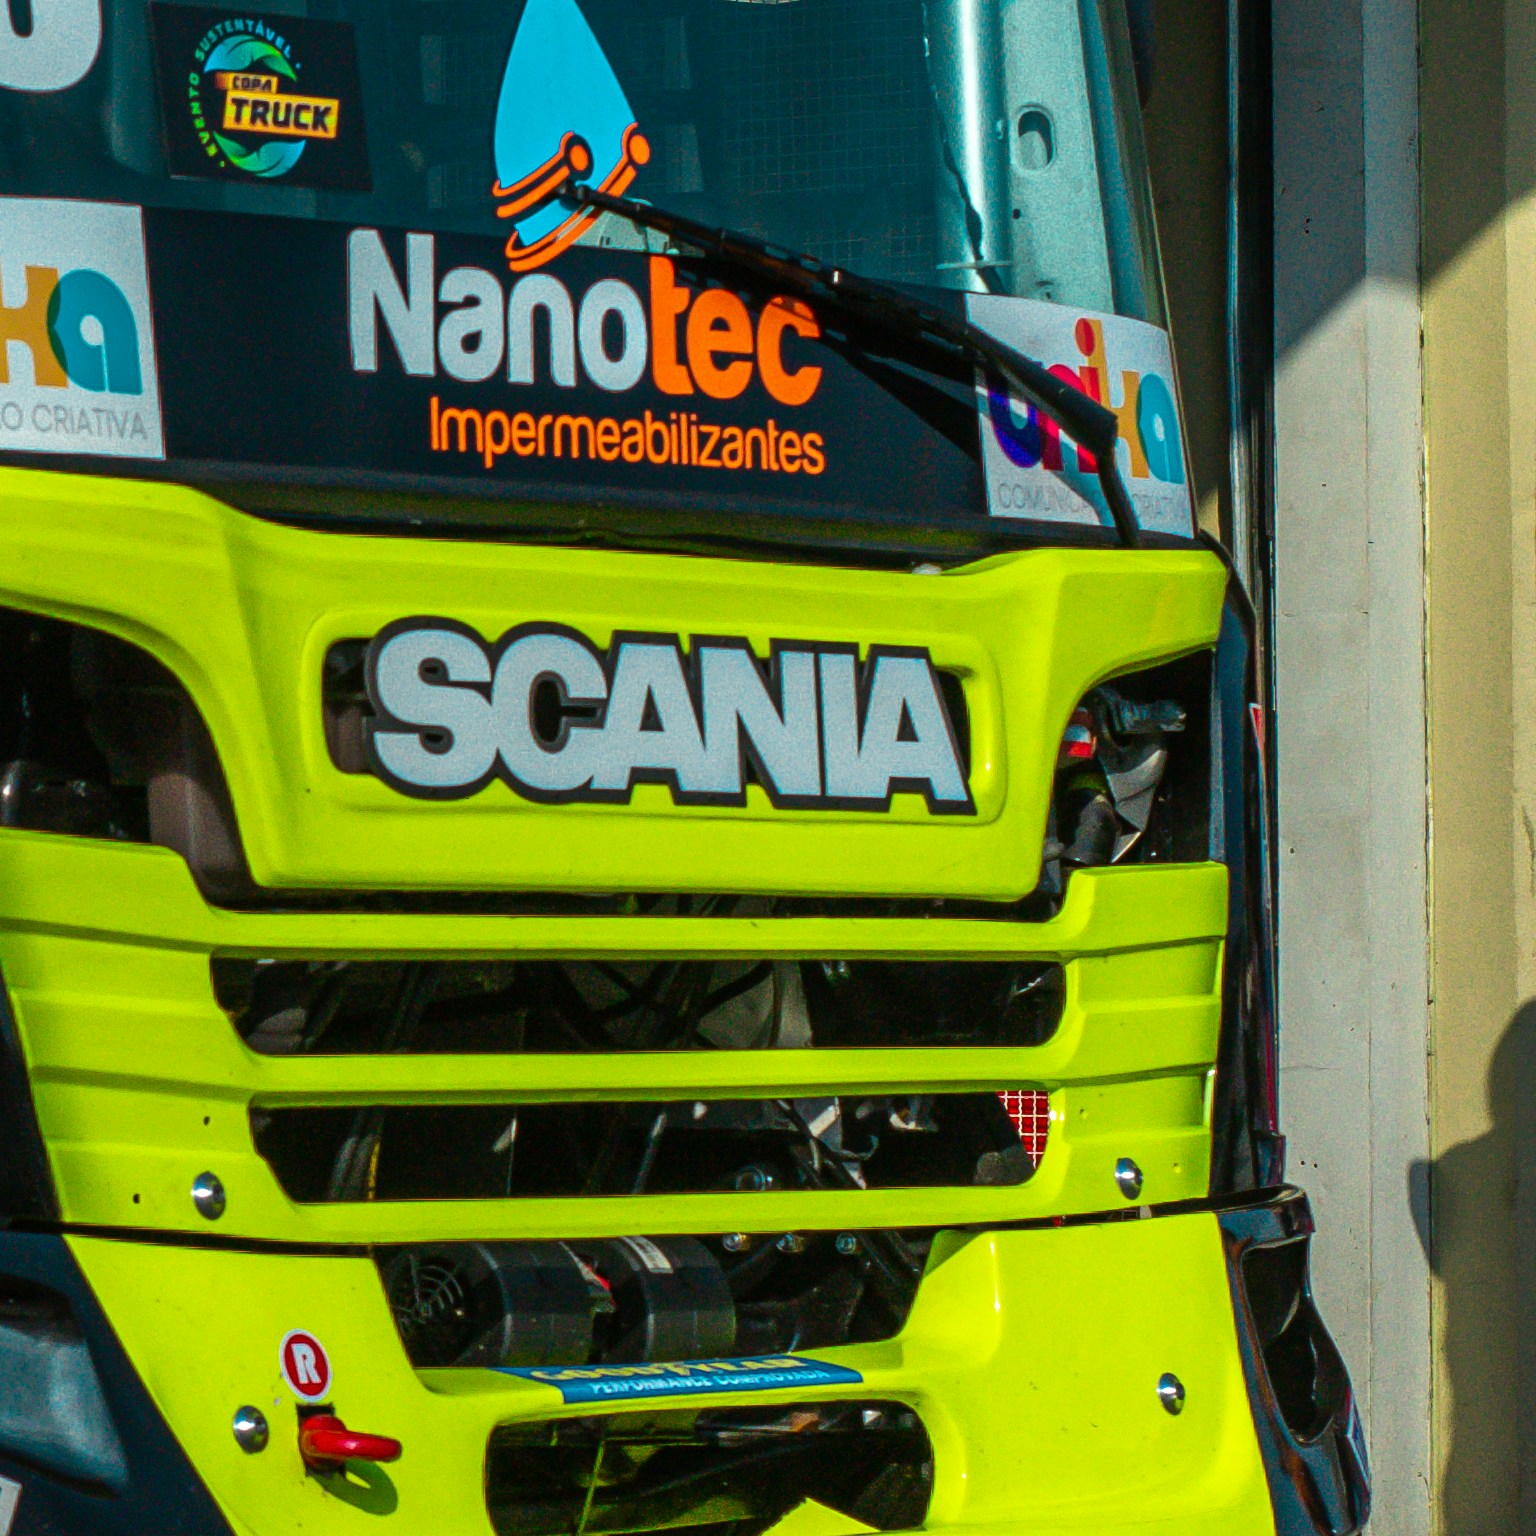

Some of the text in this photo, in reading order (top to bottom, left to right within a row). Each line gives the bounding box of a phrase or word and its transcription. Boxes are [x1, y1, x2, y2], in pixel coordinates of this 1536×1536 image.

[232, 75, 273, 92] COPA
[230, 97, 333, 134] TRUCK
[346, 227, 823, 407] Nanotec
[31, 403, 149, 441] CRIATIVA
[430, 396, 825, 475] Impermeabilizantes
[372, 624, 972, 806] SCANIA
[291, 1344, 320, 1385] R
[588, 1374, 713, 1395] PERFORMANCE
